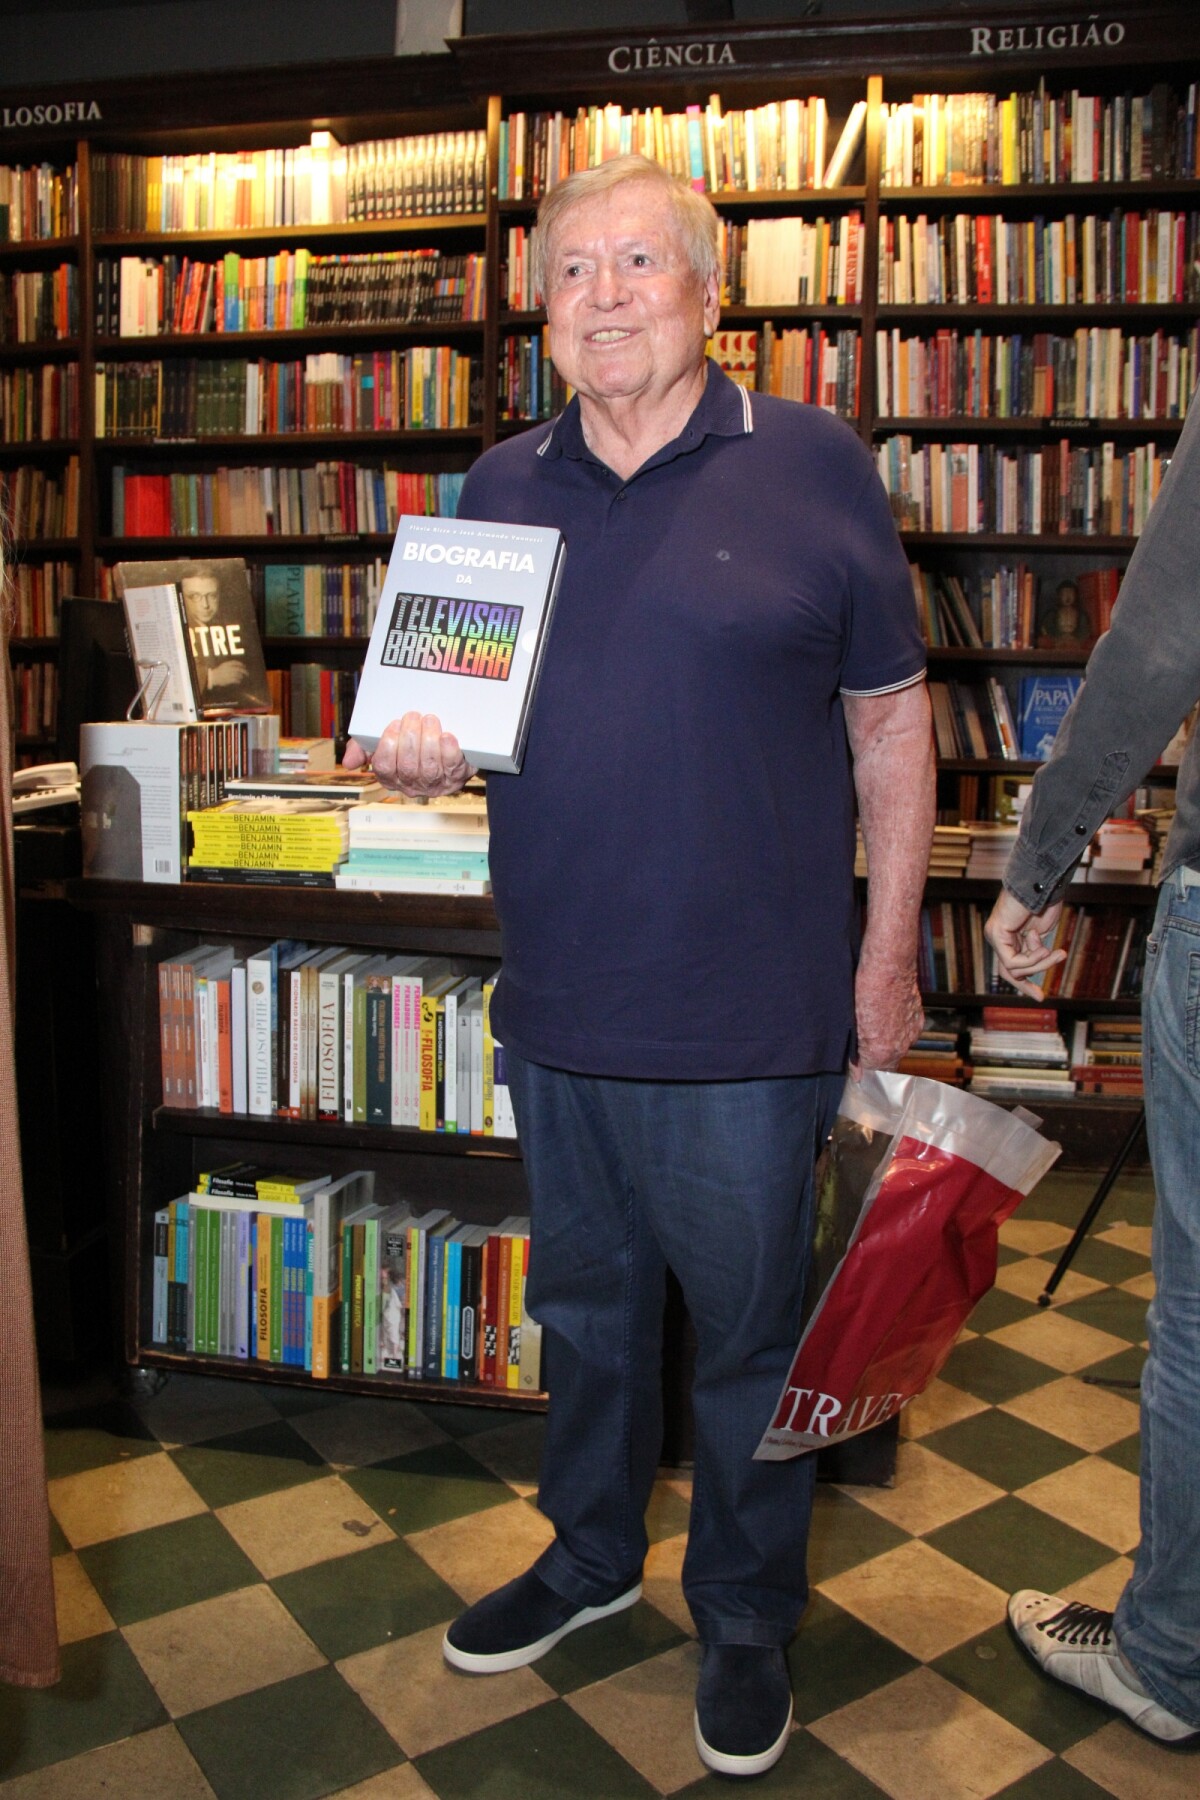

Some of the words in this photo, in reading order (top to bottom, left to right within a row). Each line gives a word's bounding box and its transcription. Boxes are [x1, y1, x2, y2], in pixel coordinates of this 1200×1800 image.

[969, 14, 1125, 55] RELIGIÃO
[608, 38, 736, 73] CIÊNCIA
[0, 101, 103, 127] LOSOFIA
[402, 542, 535, 574] BIOGRAFIA
[455, 574, 473, 585] DA
[287, 567, 302, 635] PLATÃO
[394, 594, 522, 643] TELEVISÃO
[383, 629, 514, 679] BRASILEIRA
[1034, 689, 1071, 706] PAPA
[233, 814, 276, 823] BENJAMIN
[238, 824, 280, 832] BENJAMIN
[240, 834, 282, 842] BENJAMIN
[240, 843, 283, 851] BENJAMIN
[233, 859, 275, 868] BENJAMIN
[238, 851, 279, 860] BENJAMIN
[255, 998, 268, 1094] PHILOSOPHIE
[321, 1002, 335, 1101] FILOSOFIA
